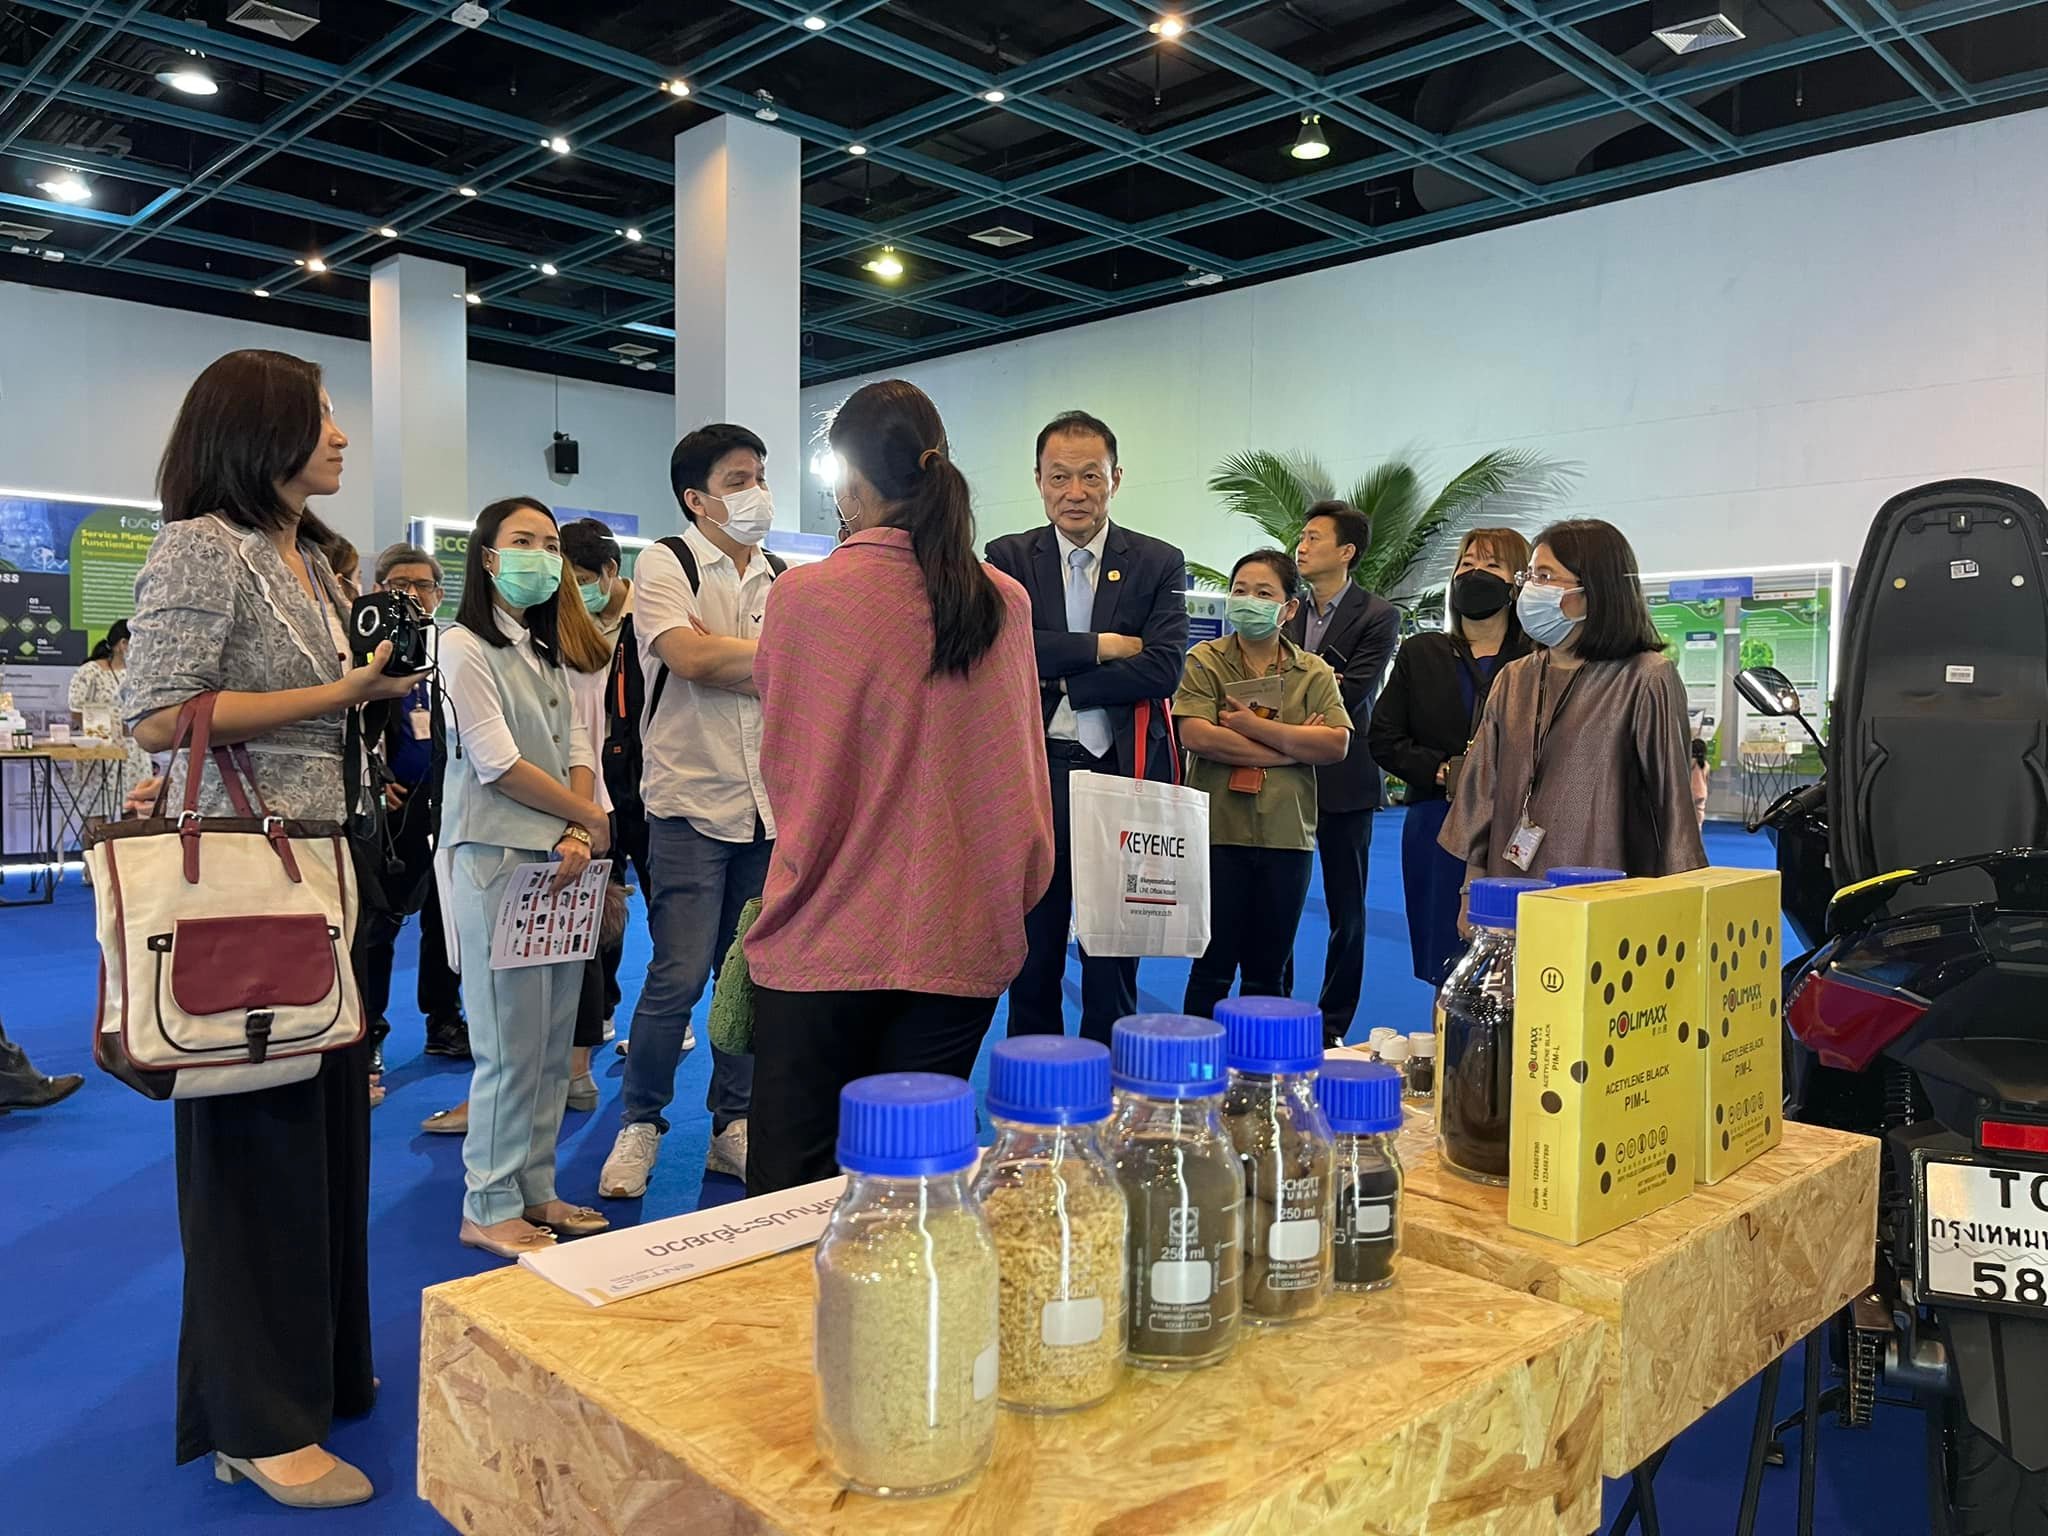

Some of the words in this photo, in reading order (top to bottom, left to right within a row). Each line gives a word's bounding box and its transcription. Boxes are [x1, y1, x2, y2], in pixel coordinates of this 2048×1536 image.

[81, 528, 118, 539] Service
[81, 538, 134, 550] Functional
[434, 536, 469, 553] BCG
[1120, 831, 1185, 858] KEYENCE
[1723, 984, 1762, 1012] POLIMAXX
[1609, 1003, 1668, 1038] POLIMAXX
[1528, 1026, 1539, 1080] POLIMAXX
[1552, 1045, 1561, 1072] PIM-L
[1605, 1070, 1645, 1096] ACETYLENE
[1646, 1064, 1671, 1082] BLACK
[1624, 1089, 1650, 1112] PIM-L
[1279, 1207, 1301, 1220] 250
[1303, 1204, 1316, 1218] ml
[1161, 1247, 1187, 1260] 250
[1189, 1246, 1206, 1260] ml
[1973, 1262, 2048, 1306] 58
